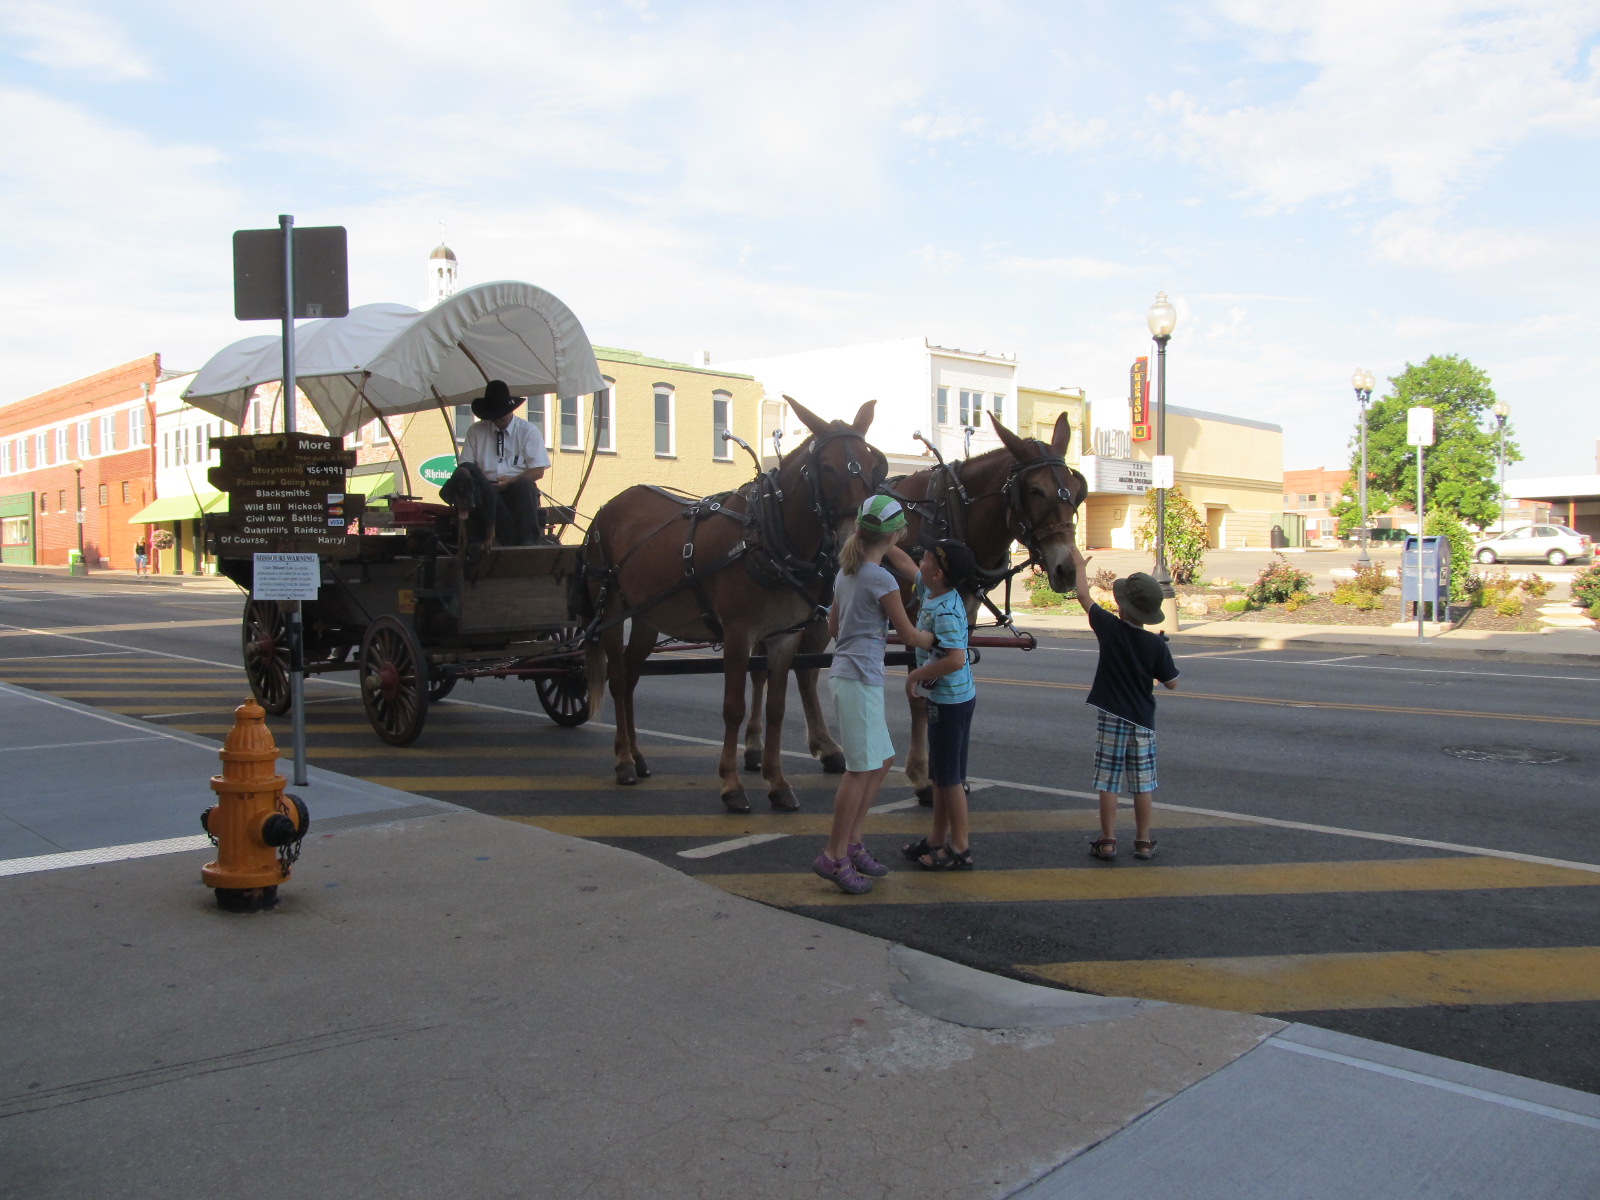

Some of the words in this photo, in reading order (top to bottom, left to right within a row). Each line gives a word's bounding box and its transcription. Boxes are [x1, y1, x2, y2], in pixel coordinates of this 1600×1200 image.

[298, 440, 331, 450] More
[252, 466, 304, 474] Storytelling
[424, 468, 452, 480] Rheinla
[236, 478, 276, 486] Pioneers
[280, 478, 306, 487] Going
[256, 490, 310, 498] Blacksmiths
[292, 514, 323, 522] Battles
[244, 526, 288, 534] Quantrill's
[234, 536, 268, 544] Course,
[318, 537, 346, 546] Harry!
